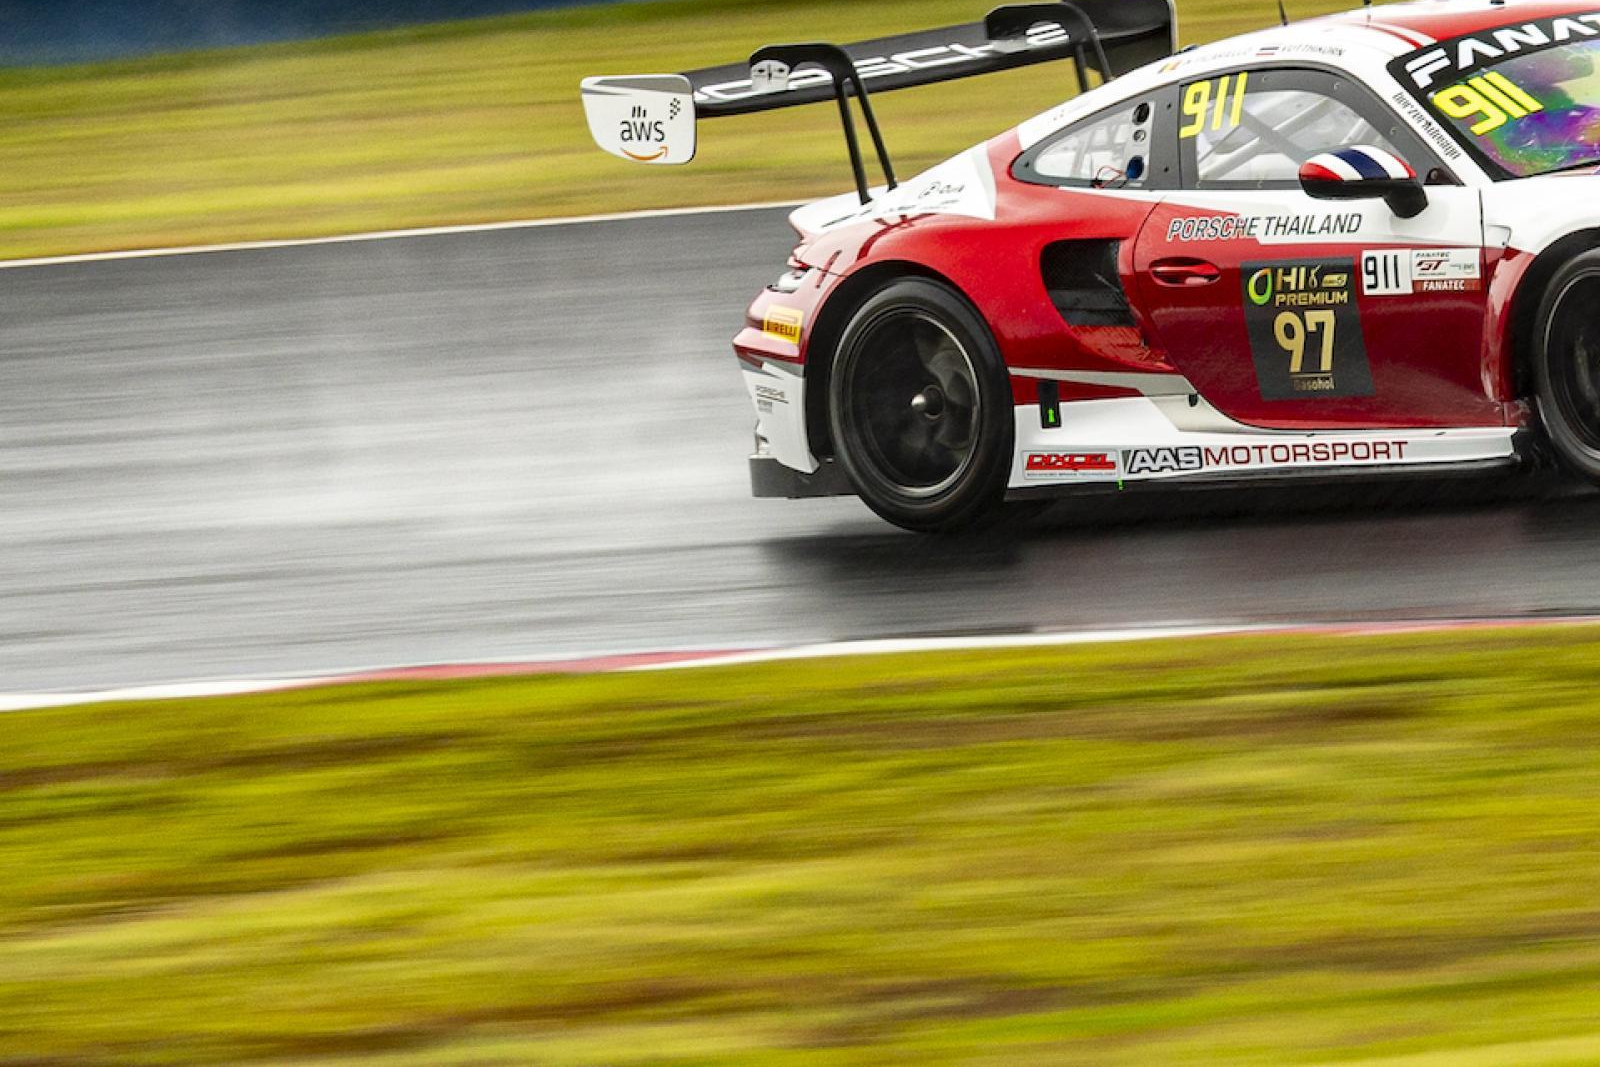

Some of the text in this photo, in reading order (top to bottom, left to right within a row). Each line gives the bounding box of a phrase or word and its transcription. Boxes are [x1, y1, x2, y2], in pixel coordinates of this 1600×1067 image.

[1179, 72, 1248, 139] 911
[1431, 71, 1545, 136] 911
[620, 119, 665, 143] aws
[1167, 212, 1363, 241] PORSCHE THAILAND
[1365, 254, 1400, 290] 911
[1423, 279, 1465, 291] FANATEC
[1275, 291, 1348, 307] PREMIUM
[1273, 309, 1336, 373] 97
[1127, 441, 1409, 474] AAS MOTORSPORT
